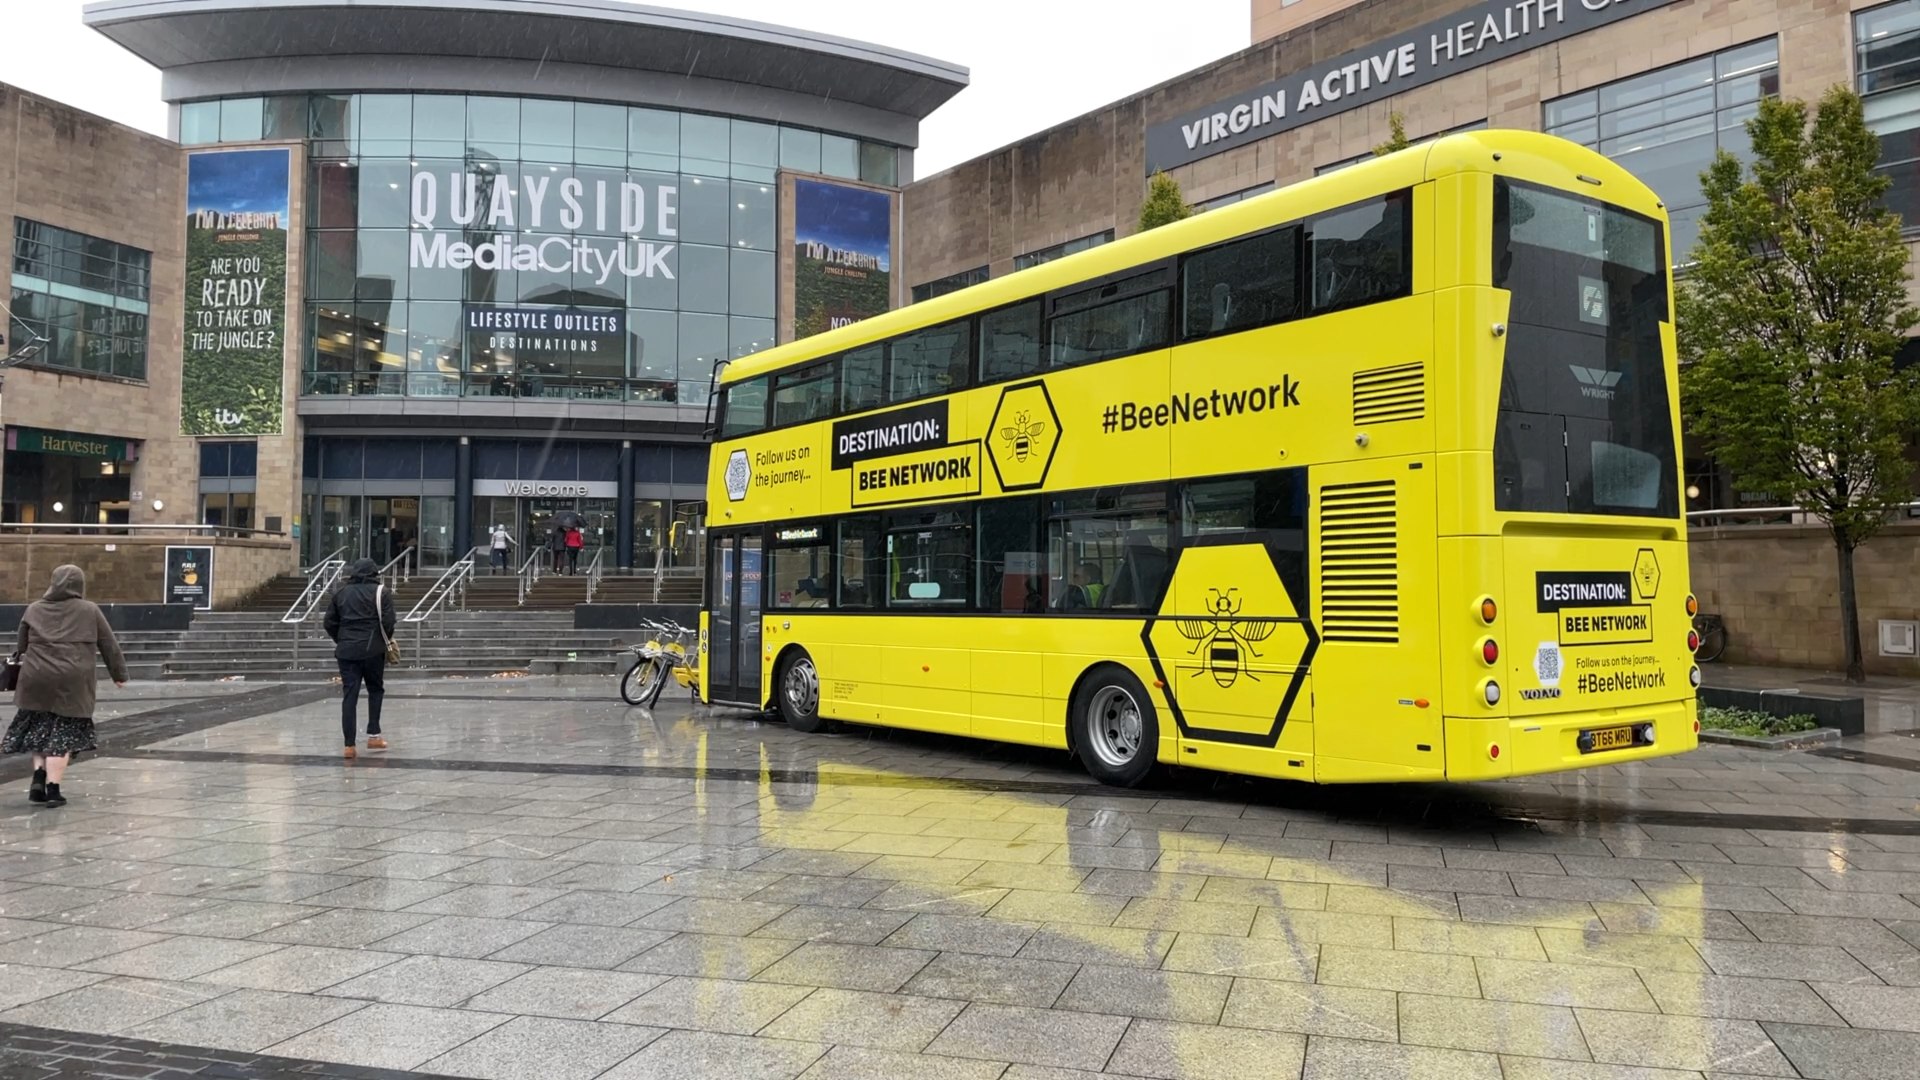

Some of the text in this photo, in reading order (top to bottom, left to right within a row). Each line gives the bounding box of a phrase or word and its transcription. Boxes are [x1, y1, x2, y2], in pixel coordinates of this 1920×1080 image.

[1181, 0, 1563, 149] VIRGIN ACTIVE HEALTH
[411, 171, 677, 236] QUAYSIDE
[217, 212, 225, 230] A
[410, 232, 676, 285] MediaCityUK
[827, 248, 835, 262] A
[209, 256, 260, 275] ARE YOU
[202, 278, 267, 306] READY
[196, 308, 272, 327] TO TAKE ON
[470, 312, 617, 333] LIFESTYLE OUTLETS
[191, 331, 275, 353] THE JUNGLE?
[489, 336, 598, 352] DESTINATIONS
[1580, 386, 1615, 401] WRIGHT
[1102, 373, 1300, 434] #BeeNetwork
[215, 408, 244, 425] itv
[42, 435, 108, 455] Harvester
[839, 418, 940, 455] DESTINATION:
[755, 447, 810, 466] Follow us on
[755, 468, 811, 488] the journey...
[859, 456, 972, 490] BEE NETWORK
[504, 480, 588, 497] Welcome
[1543, 583, 1627, 601] DESTINATION:
[1565, 614, 1648, 632] BEE NETWORK
[1576, 657, 1600, 668] Follow
[1601, 657, 1610, 667] us
[1611, 656, 1621, 666] on
[1621, 654, 1632, 666] the
[1577, 667, 1666, 694] #BeeNetwork
[1520, 688, 1562, 700] VOLVO
